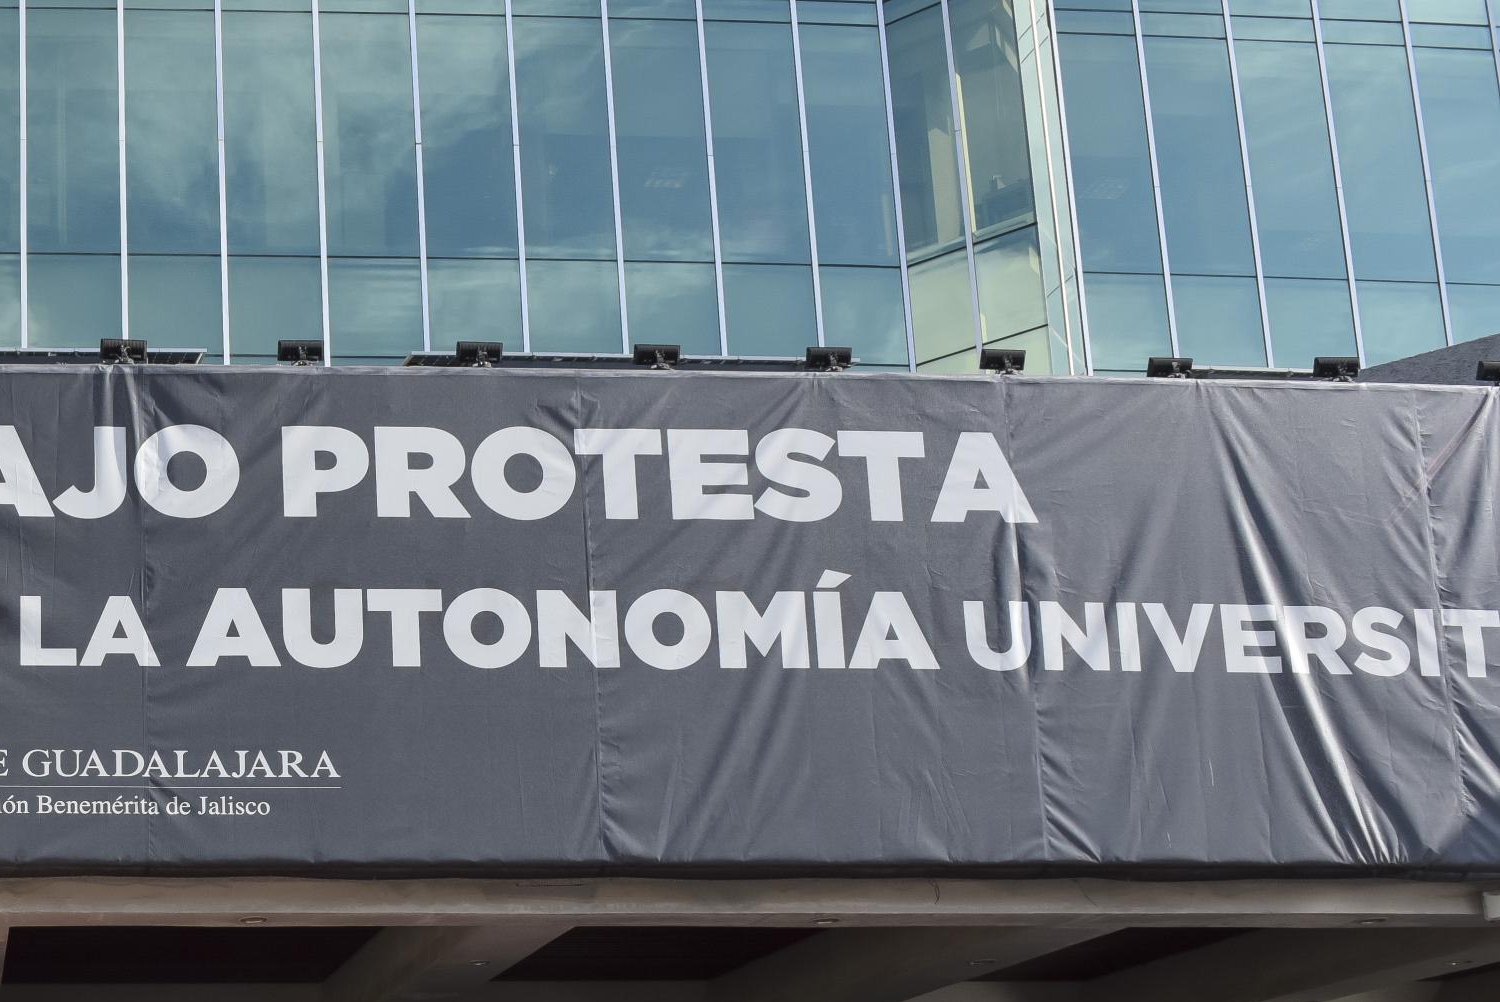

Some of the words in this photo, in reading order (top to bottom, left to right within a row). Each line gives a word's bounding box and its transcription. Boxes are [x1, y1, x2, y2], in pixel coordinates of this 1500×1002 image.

[282, 425, 1039, 524] PROTESTA
[19, 595, 161, 667] LA
[186, 569, 940, 671] AUTONOMÍA
[964, 600, 1500, 679] UNIVERSIT
[22, 749, 341, 780] GUADALAJARA
[35, 793, 161, 817] Benemérita
[165, 795, 192, 817] de
[197, 796, 271, 818] Jalisco
